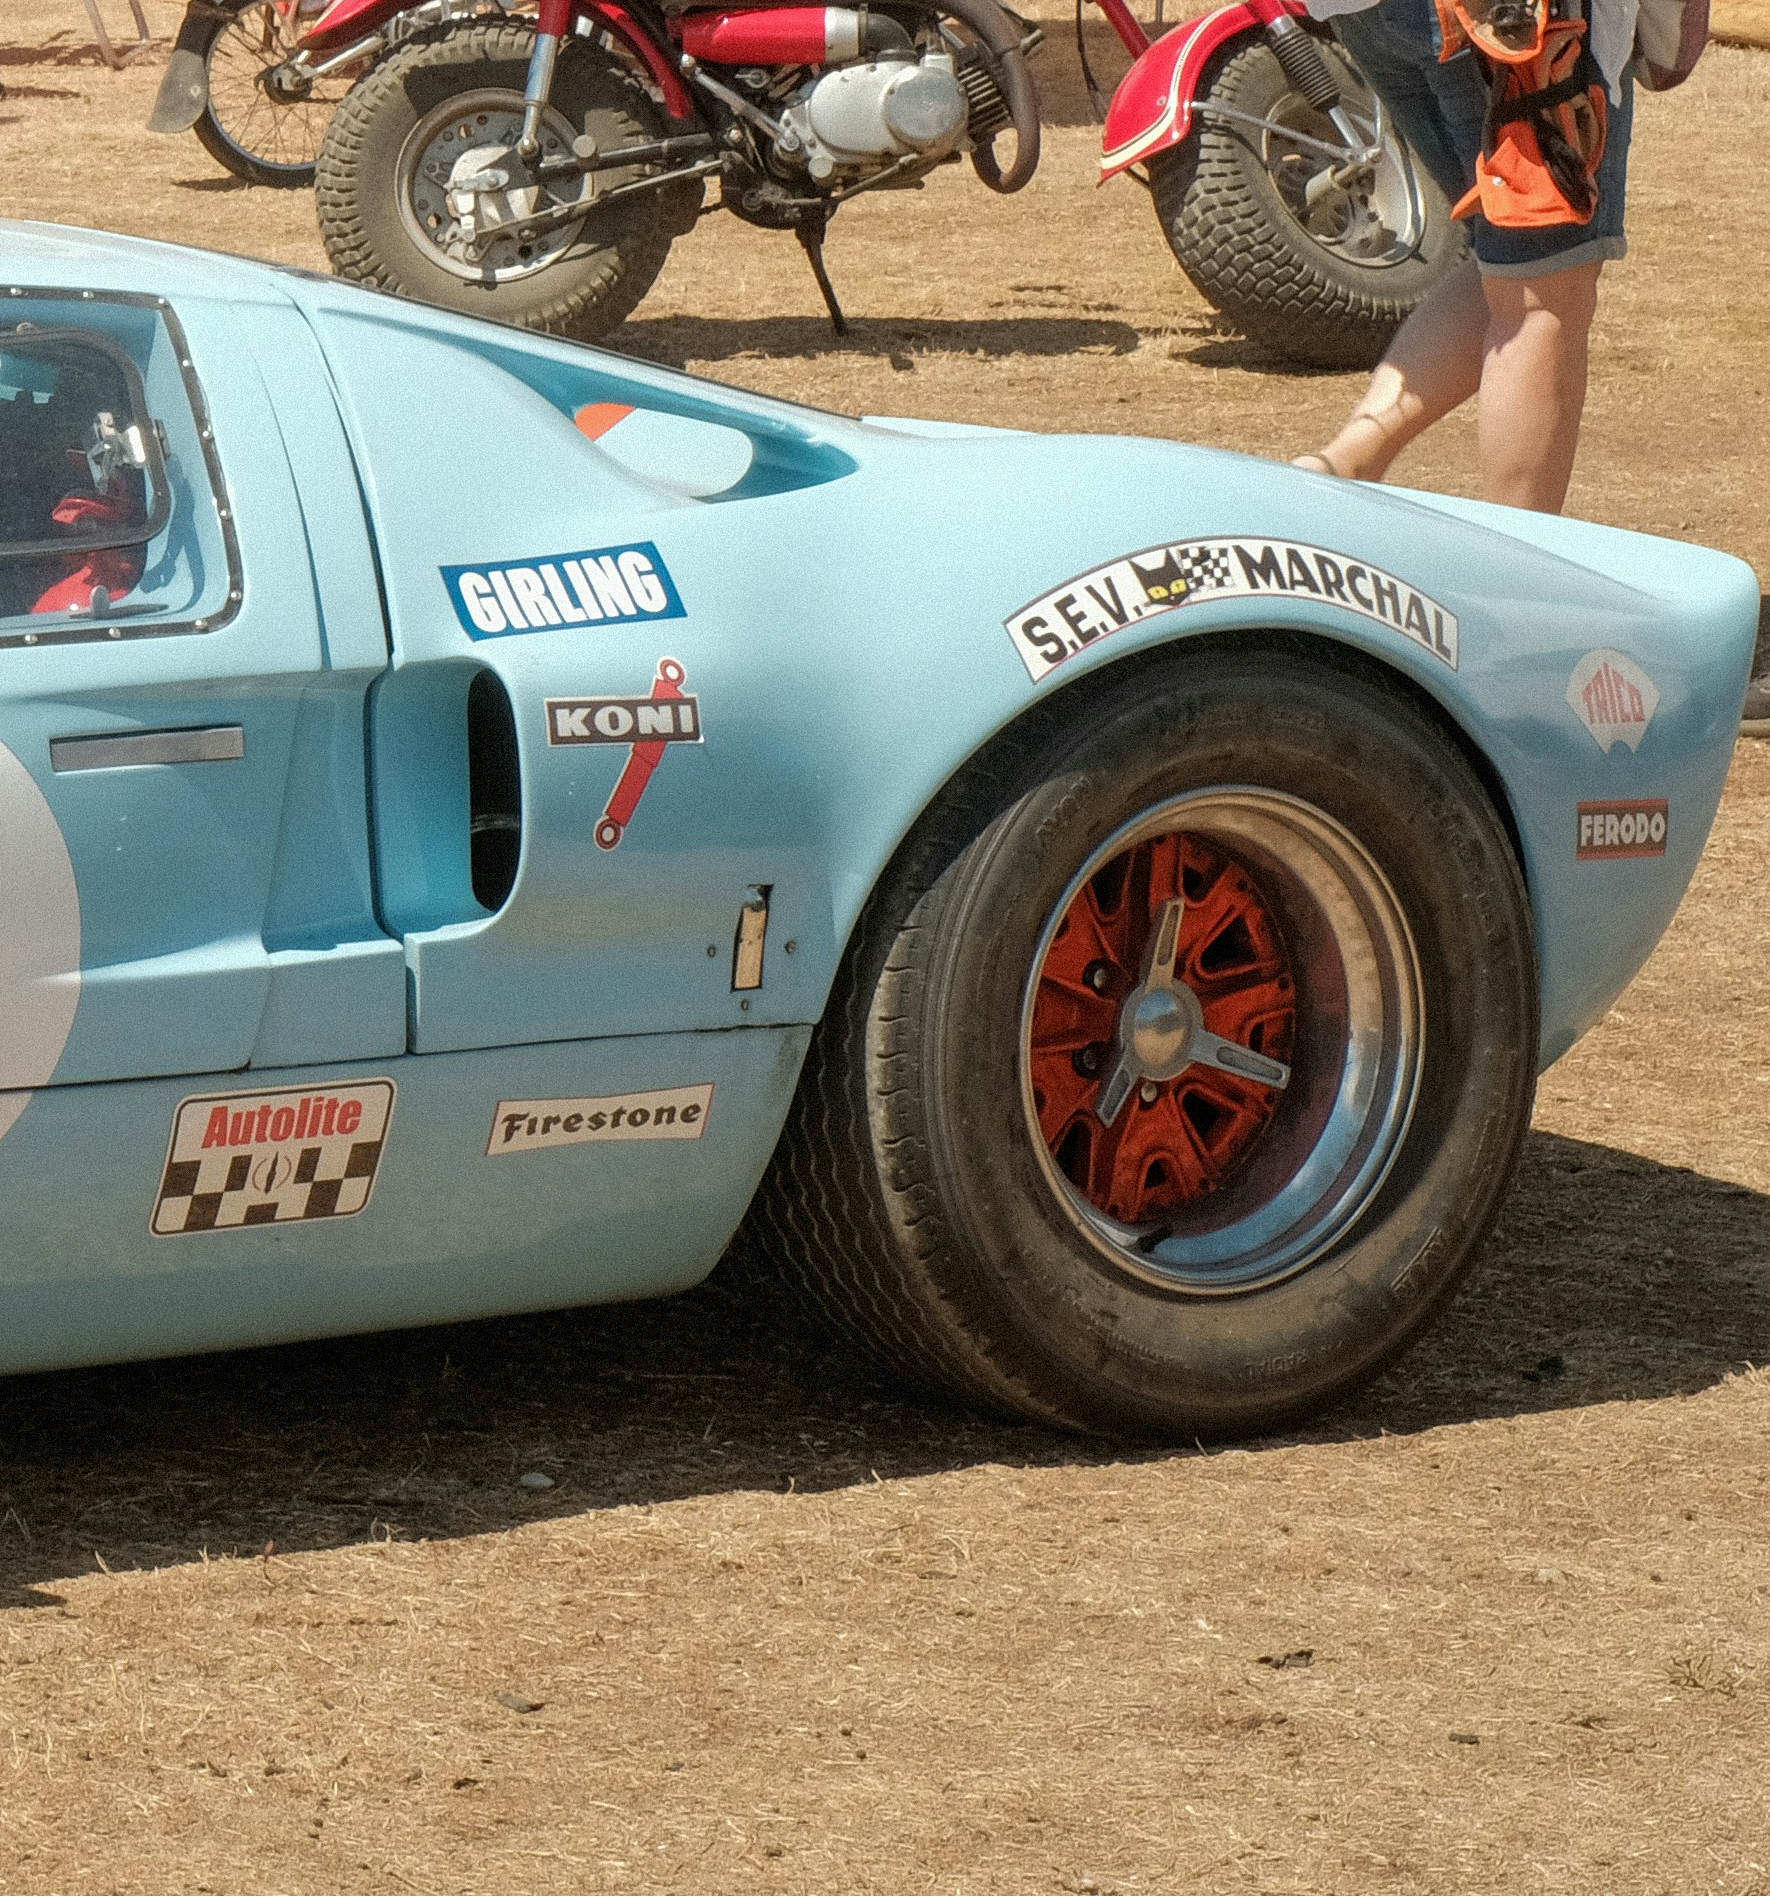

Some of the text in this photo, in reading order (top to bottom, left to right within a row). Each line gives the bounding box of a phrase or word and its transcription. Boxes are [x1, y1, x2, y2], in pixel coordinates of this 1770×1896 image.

[458, 549, 667, 635] GIRLING
[1022, 544, 1452, 665] S.E.V. MARCHAL
[555, 703, 696, 738] KONI
[1579, 811, 1666, 847] FERODO
[199, 1094, 363, 1153] Autolite
[501, 1095, 703, 1143] Firestone
